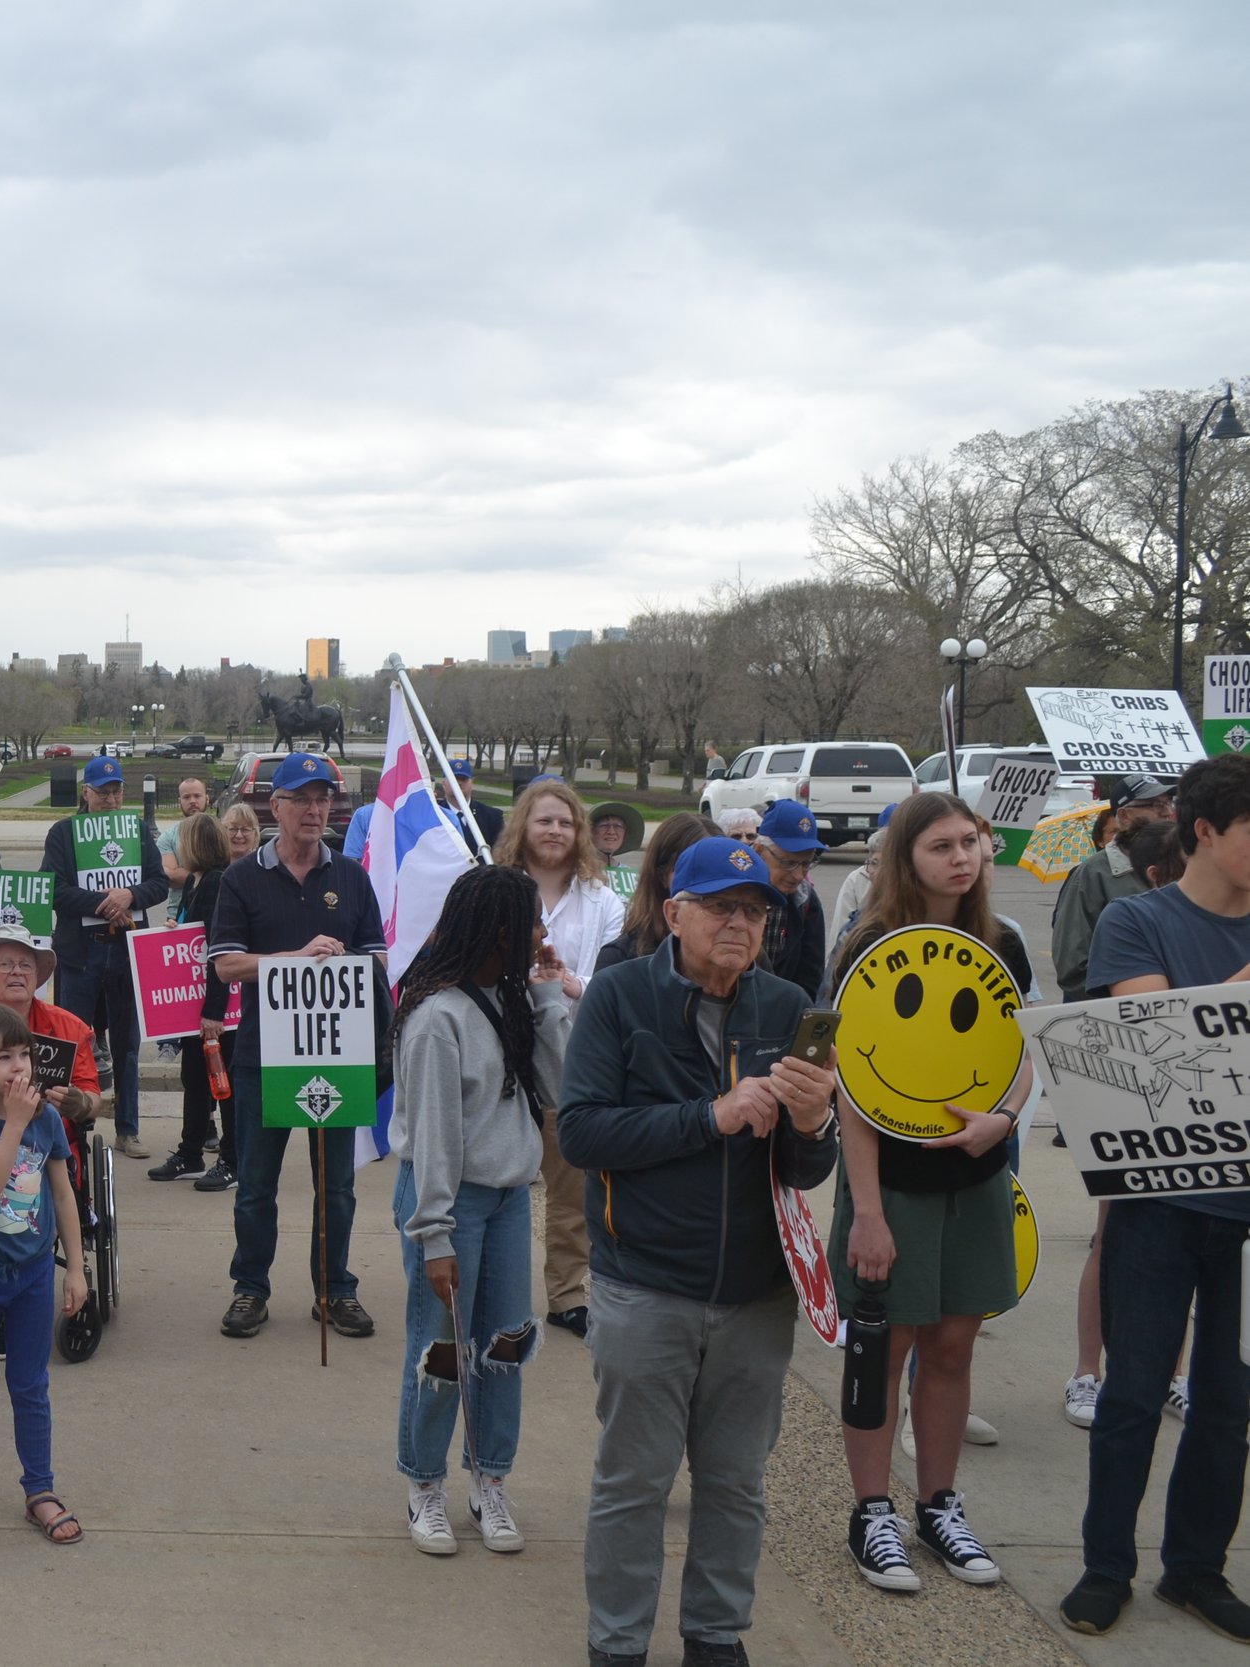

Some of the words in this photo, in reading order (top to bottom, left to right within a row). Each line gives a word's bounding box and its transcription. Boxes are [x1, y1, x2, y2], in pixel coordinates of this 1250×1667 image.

[1111, 695, 1169, 711] CRIBS
[1111, 731, 1124, 740] to
[1063, 742, 1166, 759] CROSSES
[1080, 760, 1150, 772] CHOOSE
[990, 765, 1056, 796] CHOOSE
[991, 795, 1029, 822] LIFE
[76, 816, 111, 843] LOVE
[114, 815, 138, 839] LIFE
[17, 876, 50, 905] LIFE
[267, 966, 365, 1010] CHOOSE
[858, 950, 910, 990] i'm
[922, 941, 1017, 1020] pro-life
[152, 983, 207, 1006] HUMAN
[1118, 998, 1190, 1018] EMPTY
[293, 1012, 342, 1056] LIFE
[1188, 1097, 1216, 1115] to
[871, 1107, 945, 1135] #marchforlife
[1123, 1163, 1250, 1192] CHOOS
